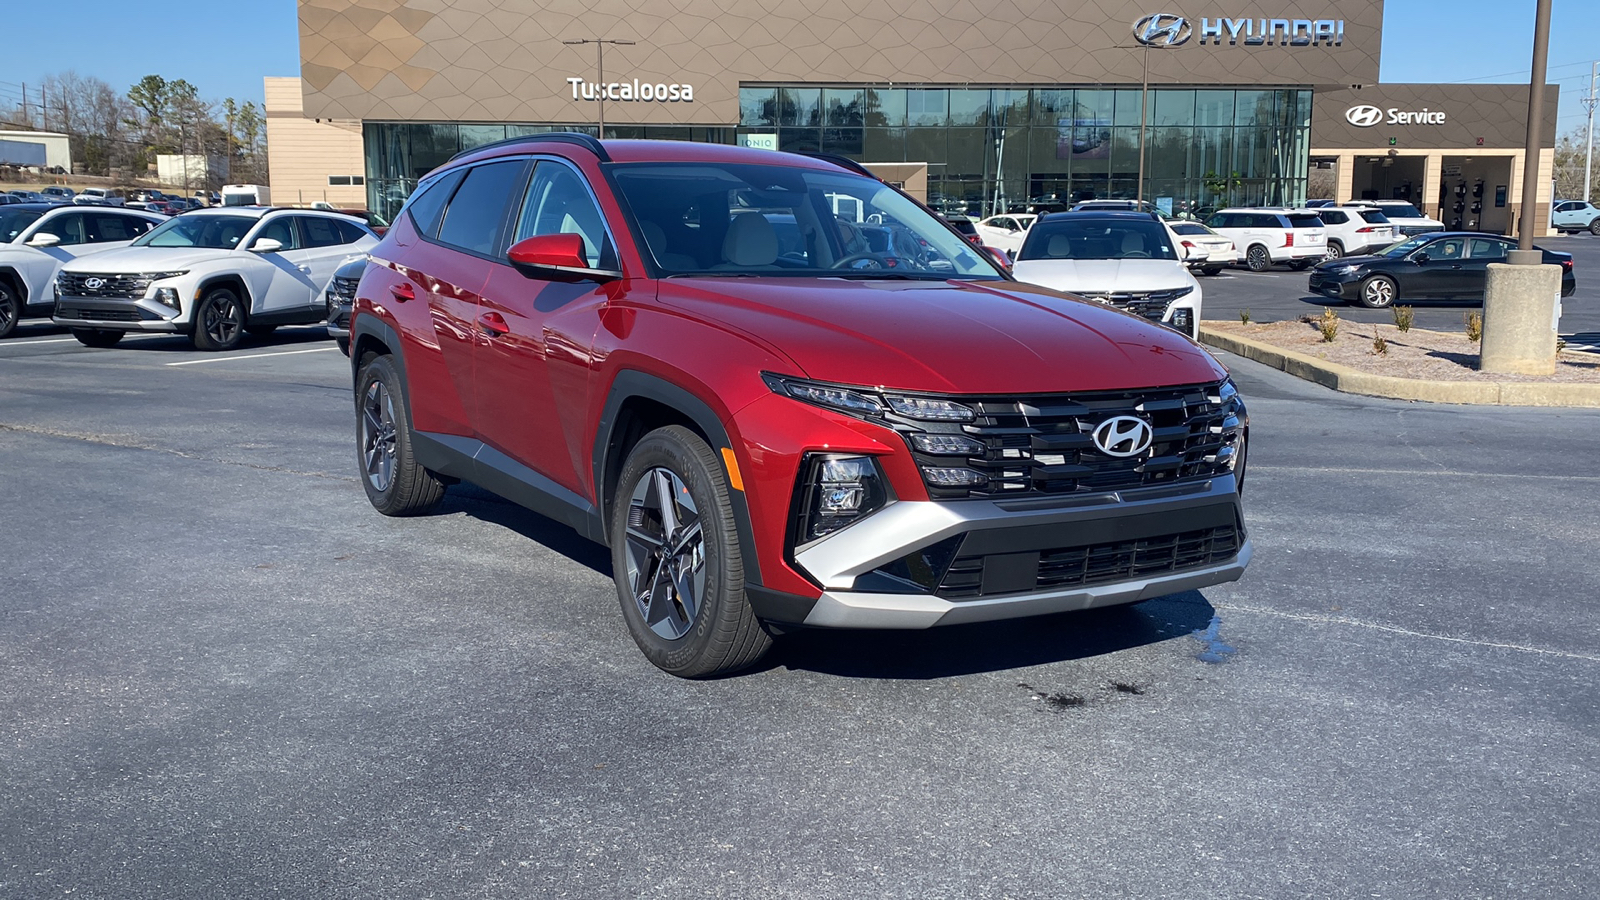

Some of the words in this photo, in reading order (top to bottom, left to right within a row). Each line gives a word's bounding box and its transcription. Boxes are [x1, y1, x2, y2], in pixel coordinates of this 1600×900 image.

[1200, 17, 1344, 46] HYUNDAI
[566, 77, 694, 102] Tuscaloosa
[1386, 108, 1446, 125] Service
[697, 575, 714, 637] KUMHO
